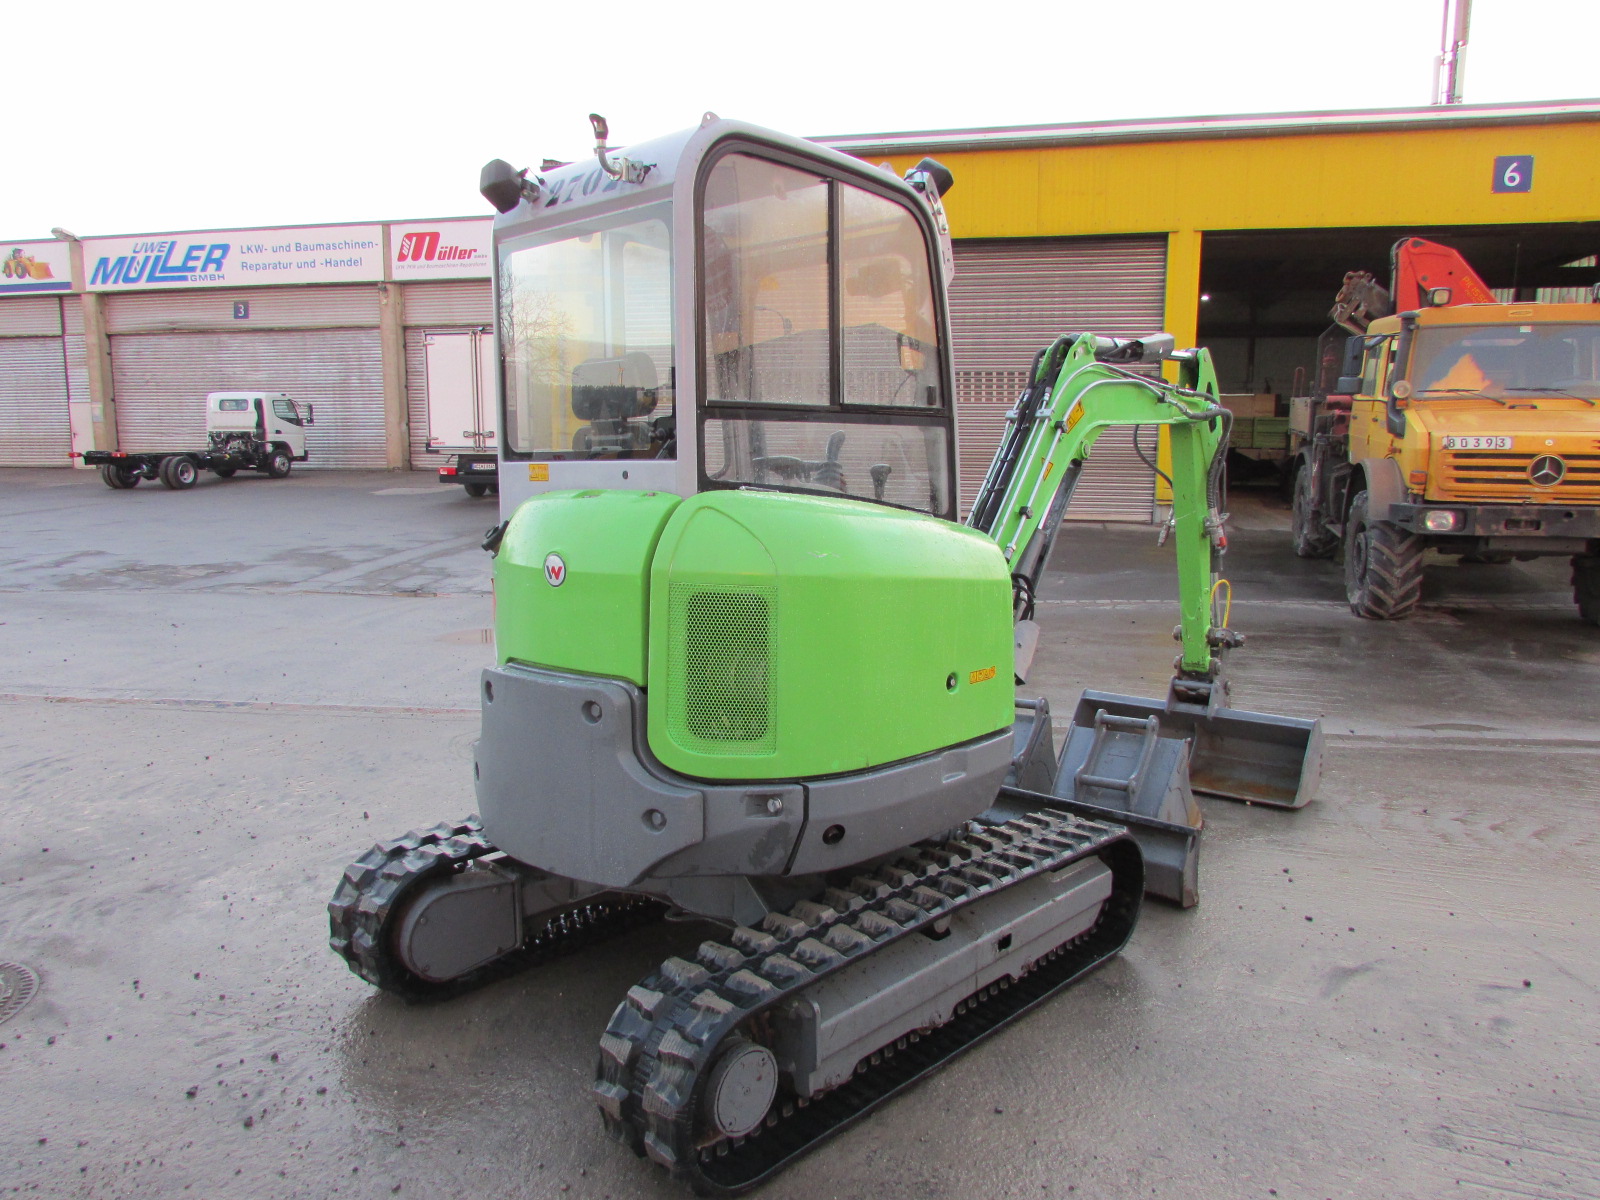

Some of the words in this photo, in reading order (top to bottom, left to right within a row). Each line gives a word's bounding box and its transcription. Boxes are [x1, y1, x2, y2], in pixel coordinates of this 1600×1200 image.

[1503, 161, 1521, 187] 6
[132, 241, 168, 253] UWE
[240, 244, 268, 254] LKW-
[272, 243, 291, 253] und
[295, 239, 379, 252] Baumaschinen-
[397, 232, 477, 262] Müller
[89, 240, 231, 285] MÜLLER
[241, 260, 293, 272] Reparatur
[296, 259, 316, 269] und
[320, 257, 363, 267] -Handel
[237, 304, 245, 316] 3
